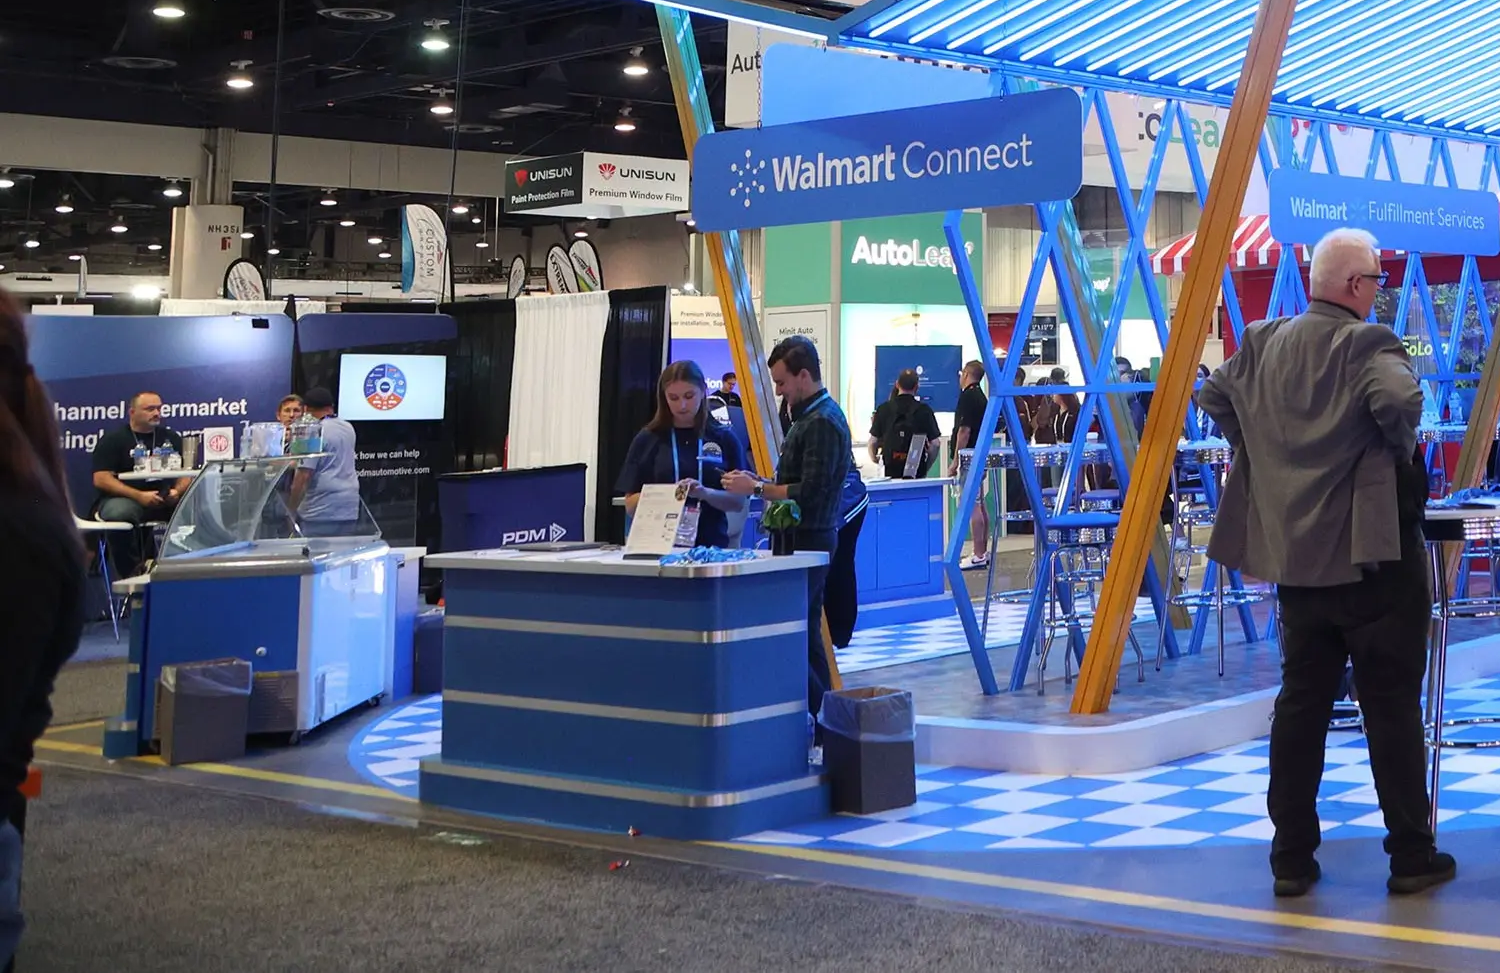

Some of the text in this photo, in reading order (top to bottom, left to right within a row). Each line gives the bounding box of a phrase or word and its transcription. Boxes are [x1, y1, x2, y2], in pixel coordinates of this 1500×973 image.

[731, 50, 762, 74] Aut
[772, 133, 1033, 192] Walmart Connect
[530, 166, 572, 182] UNISUN
[620, 168, 676, 182] UNISUN
[511, 188, 574, 204] Paint Protection Film
[589, 188, 683, 202] Premium Window Film
[1290, 196, 1485, 230] Walmart Fulfillment Services
[426, 228, 435, 277] CUSTOM
[852, 236, 960, 274] AutoLea
[705, 310, 723, 318] Windo
[779, 327, 796, 335] Minit
[54, 397, 248, 421] hannel ermarket
[359, 450, 376, 460] how
[388, 450, 403, 458] can
[404, 449, 420, 459] help
[502, 527, 546, 545] PDM
